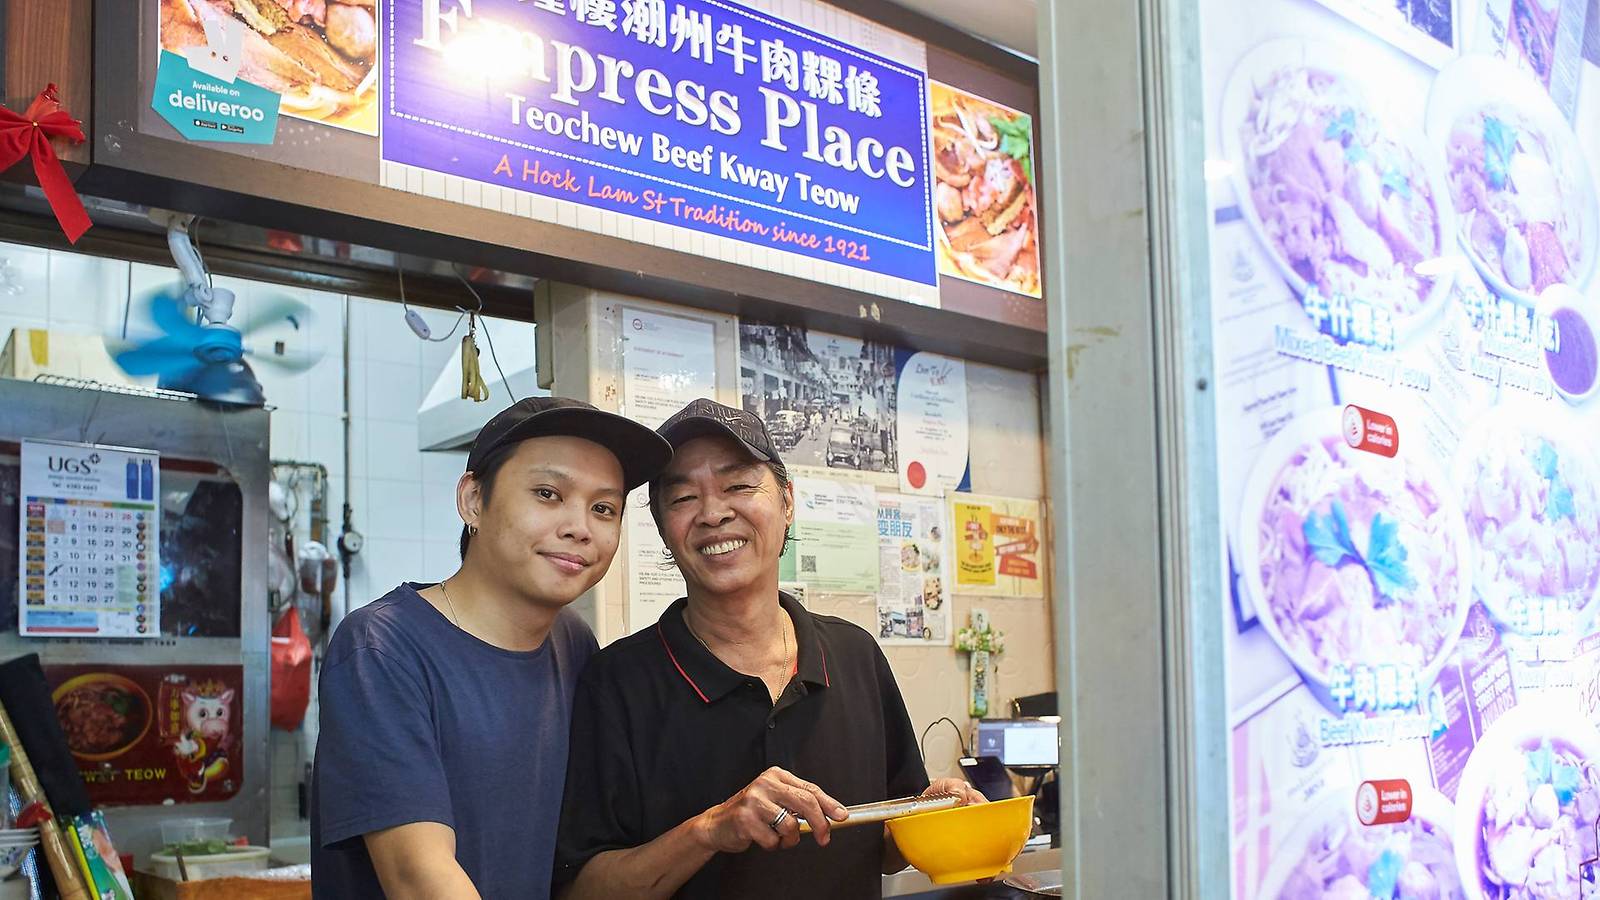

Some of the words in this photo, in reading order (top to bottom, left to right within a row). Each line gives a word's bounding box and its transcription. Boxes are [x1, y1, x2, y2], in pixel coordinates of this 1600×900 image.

[192, 80, 229, 96] Available
[229, 88, 240, 97] on
[168, 89, 265, 122] deliveroo
[504, 91, 643, 157] Teochew
[652, 132, 715, 176] Beef
[720, 151, 789, 203] Kway
[795, 172, 860, 216] Teow
[757, 85, 916, 189] Place
[493, 153, 514, 178] A
[522, 158, 582, 194] Hock
[588, 174, 640, 205] Lam
[642, 189, 668, 215] St
[670, 196, 770, 237] Tradition
[771, 221, 821, 249] since
[824, 234, 871, 262] 1921
[48, 456, 91, 475] UGS
[124, 768, 167, 781] TEOW
